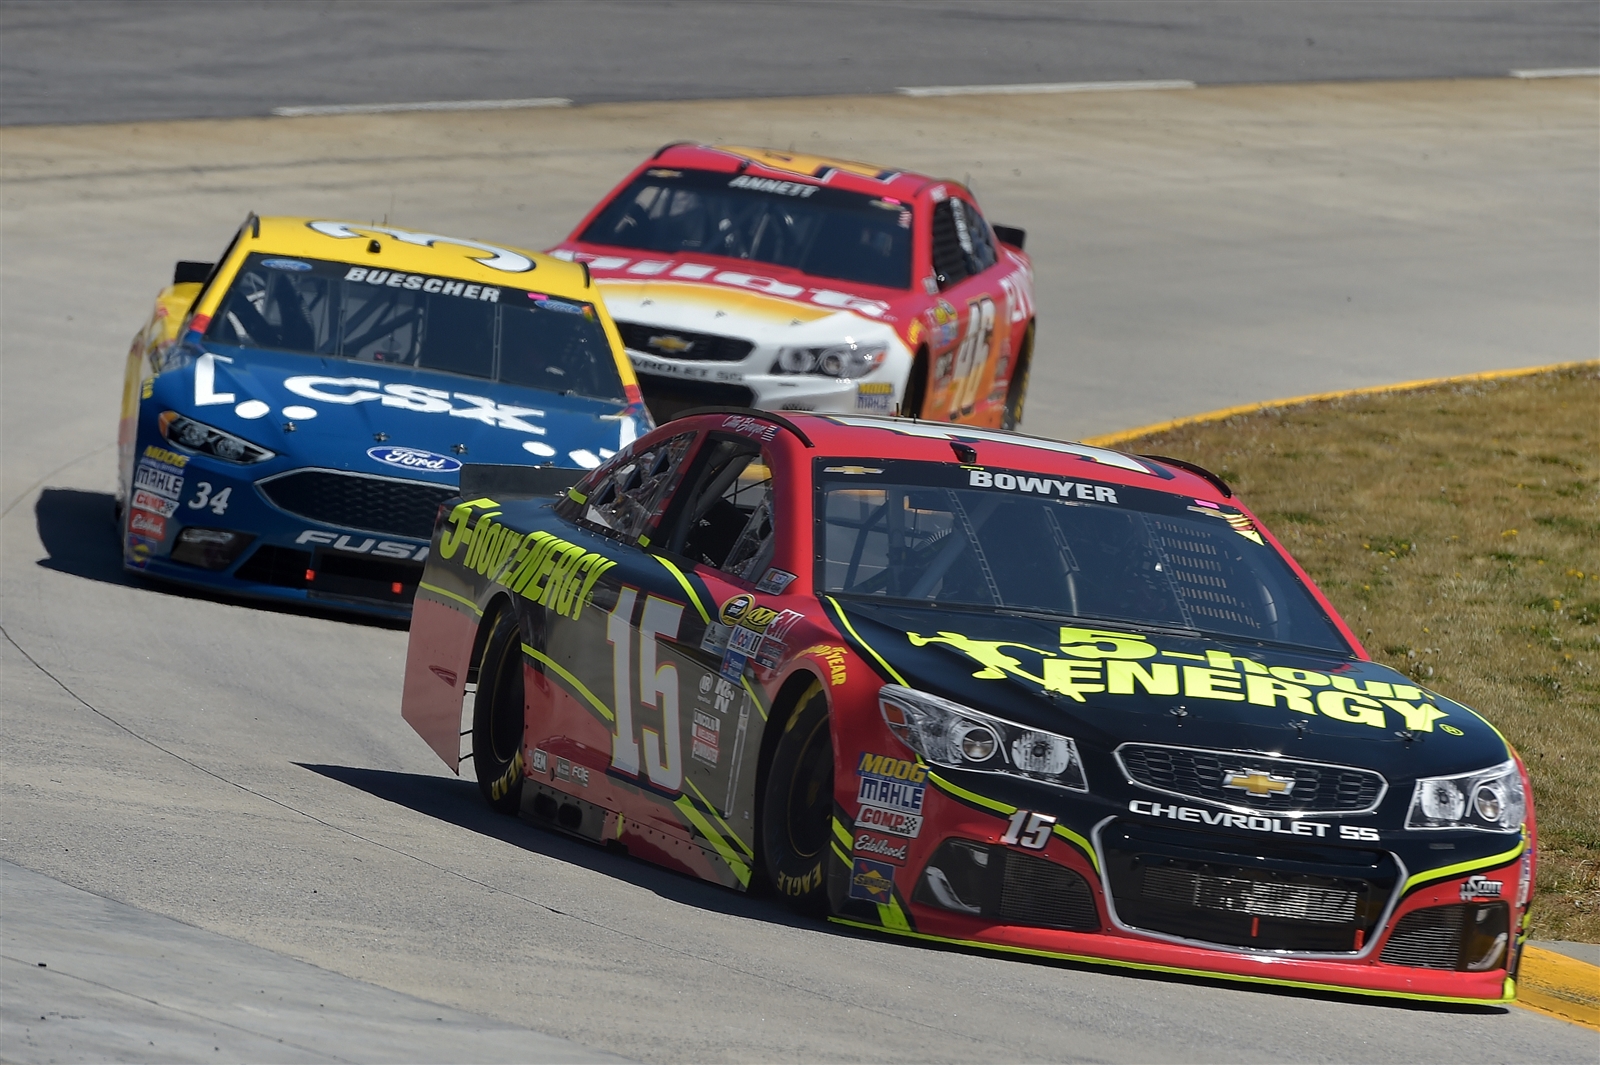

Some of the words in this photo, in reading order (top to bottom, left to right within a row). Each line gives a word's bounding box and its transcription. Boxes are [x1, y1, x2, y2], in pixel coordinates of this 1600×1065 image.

[728, 175, 820, 198] ANNETT
[345, 267, 500, 302] BUESCHER
[631, 357, 709, 381] VROLET
[284, 375, 546, 436] CSX
[144, 445, 190, 467] MOOG
[384, 448, 444, 470] Ford
[139, 468, 181, 494] MAHLE
[969, 470, 1119, 504] BOWYER
[188, 482, 232, 515] 34
[296, 530, 430, 561] FUSI
[497, 531, 617, 621] ENERGY
[1060, 627, 1436, 701] 5-hour
[606, 586, 686, 794] 15
[1043, 659, 1449, 733] ENERGY
[859, 753, 930, 783] MOOG
[860, 778, 922, 809] MAHLE
[861, 808, 904, 828] COMP
[1001, 810, 1057, 850] 15
[1129, 800, 1331, 837] CHEVROLET
[1339, 825, 1380, 842] SS
[854, 834, 907, 859] Edelbrock
[776, 861, 822, 897] EAGLE
